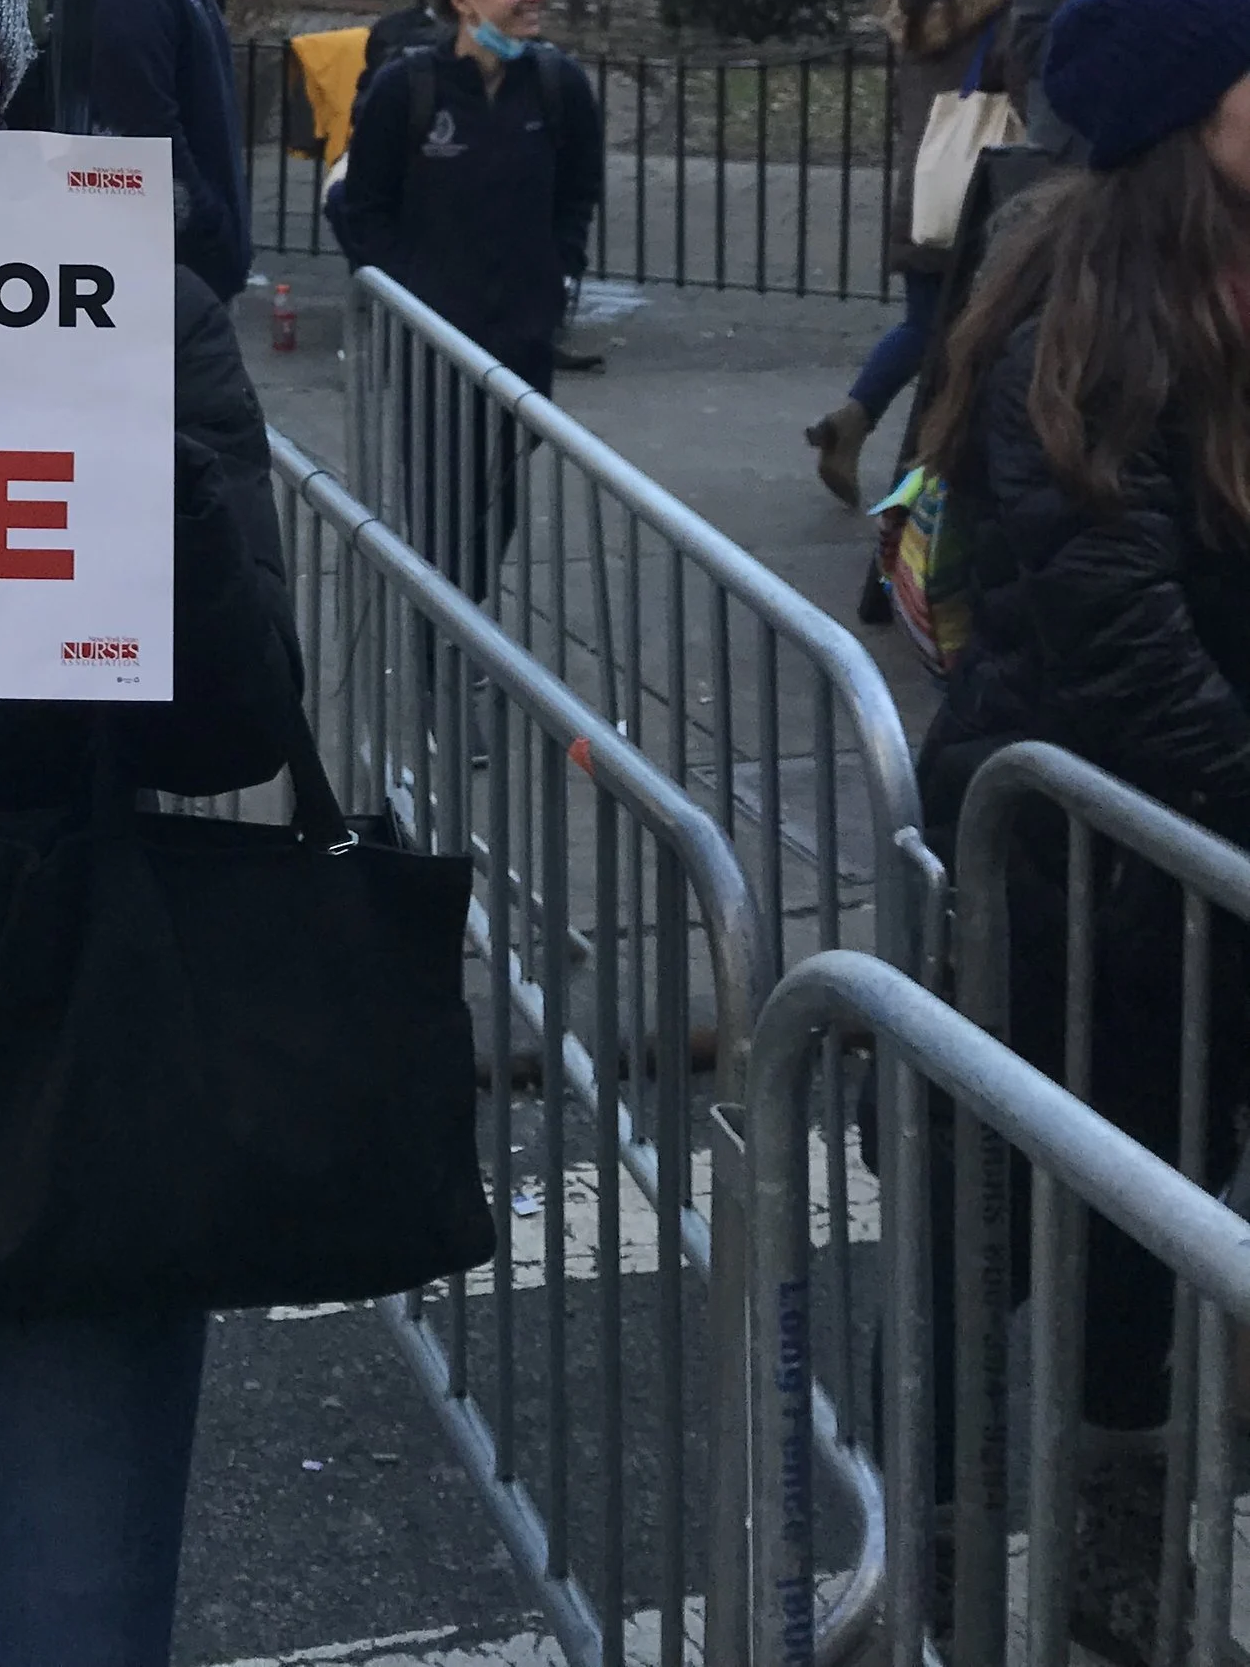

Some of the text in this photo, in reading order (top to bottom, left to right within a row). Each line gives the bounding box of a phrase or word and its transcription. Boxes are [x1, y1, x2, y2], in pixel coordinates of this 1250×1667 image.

[67, 171, 143, 189] NURSES
[67, 187, 145, 196] ASSOCIATION
[61, 642, 139, 659] NURSES
[61, 659, 141, 667] ASSOCIATION
[777, 1281, 807, 1392] Long
